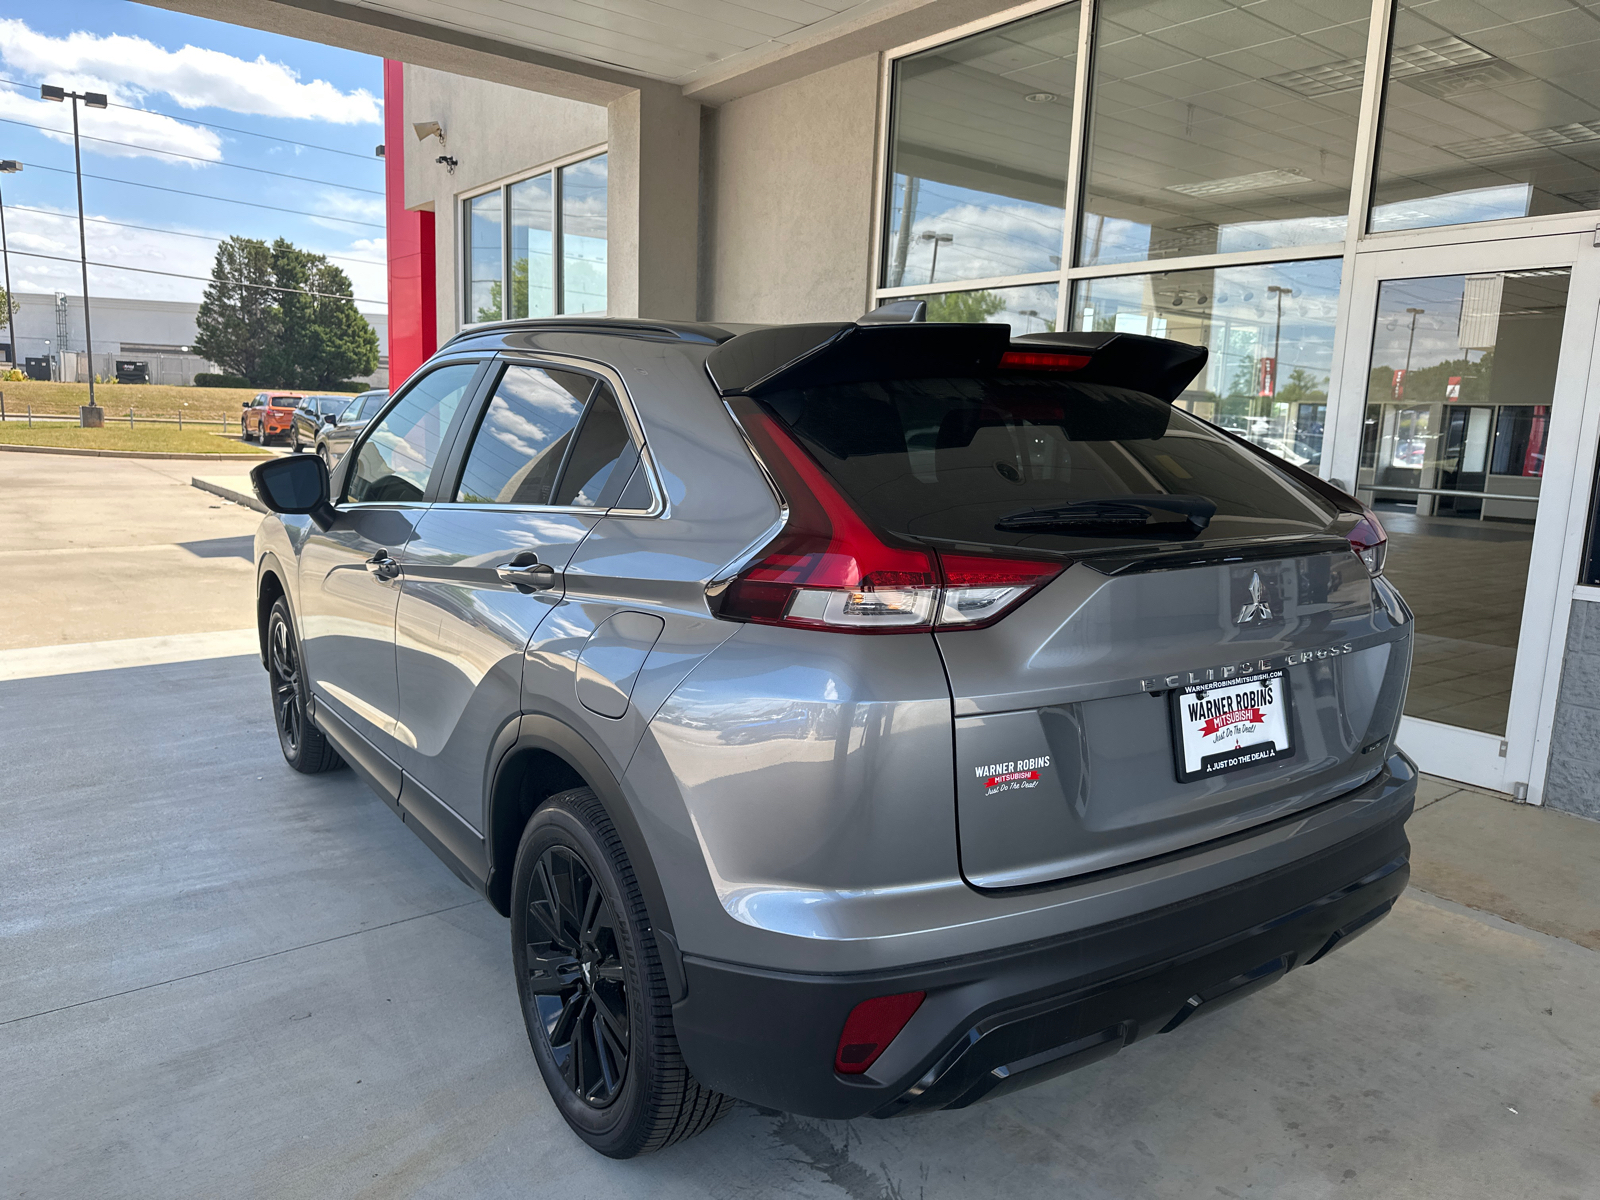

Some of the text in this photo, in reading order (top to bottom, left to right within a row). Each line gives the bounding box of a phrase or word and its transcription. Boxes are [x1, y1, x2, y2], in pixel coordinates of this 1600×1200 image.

[1141, 642, 1353, 692] ECLIPSE CROSS
[1188, 687, 1273, 722] WARNER ROBINS
[1213, 710, 1253, 728] MITSUBISHI
[1212, 724, 1257, 744] Just Do The Deal!
[975, 755, 1050, 778] WARNER ROBINS
[1212, 750, 1269, 770] JUST DO THE DEAL!
[994, 771, 1032, 783] MITSUBISHI
[985, 780, 1039, 796] Just Do The Deal!
